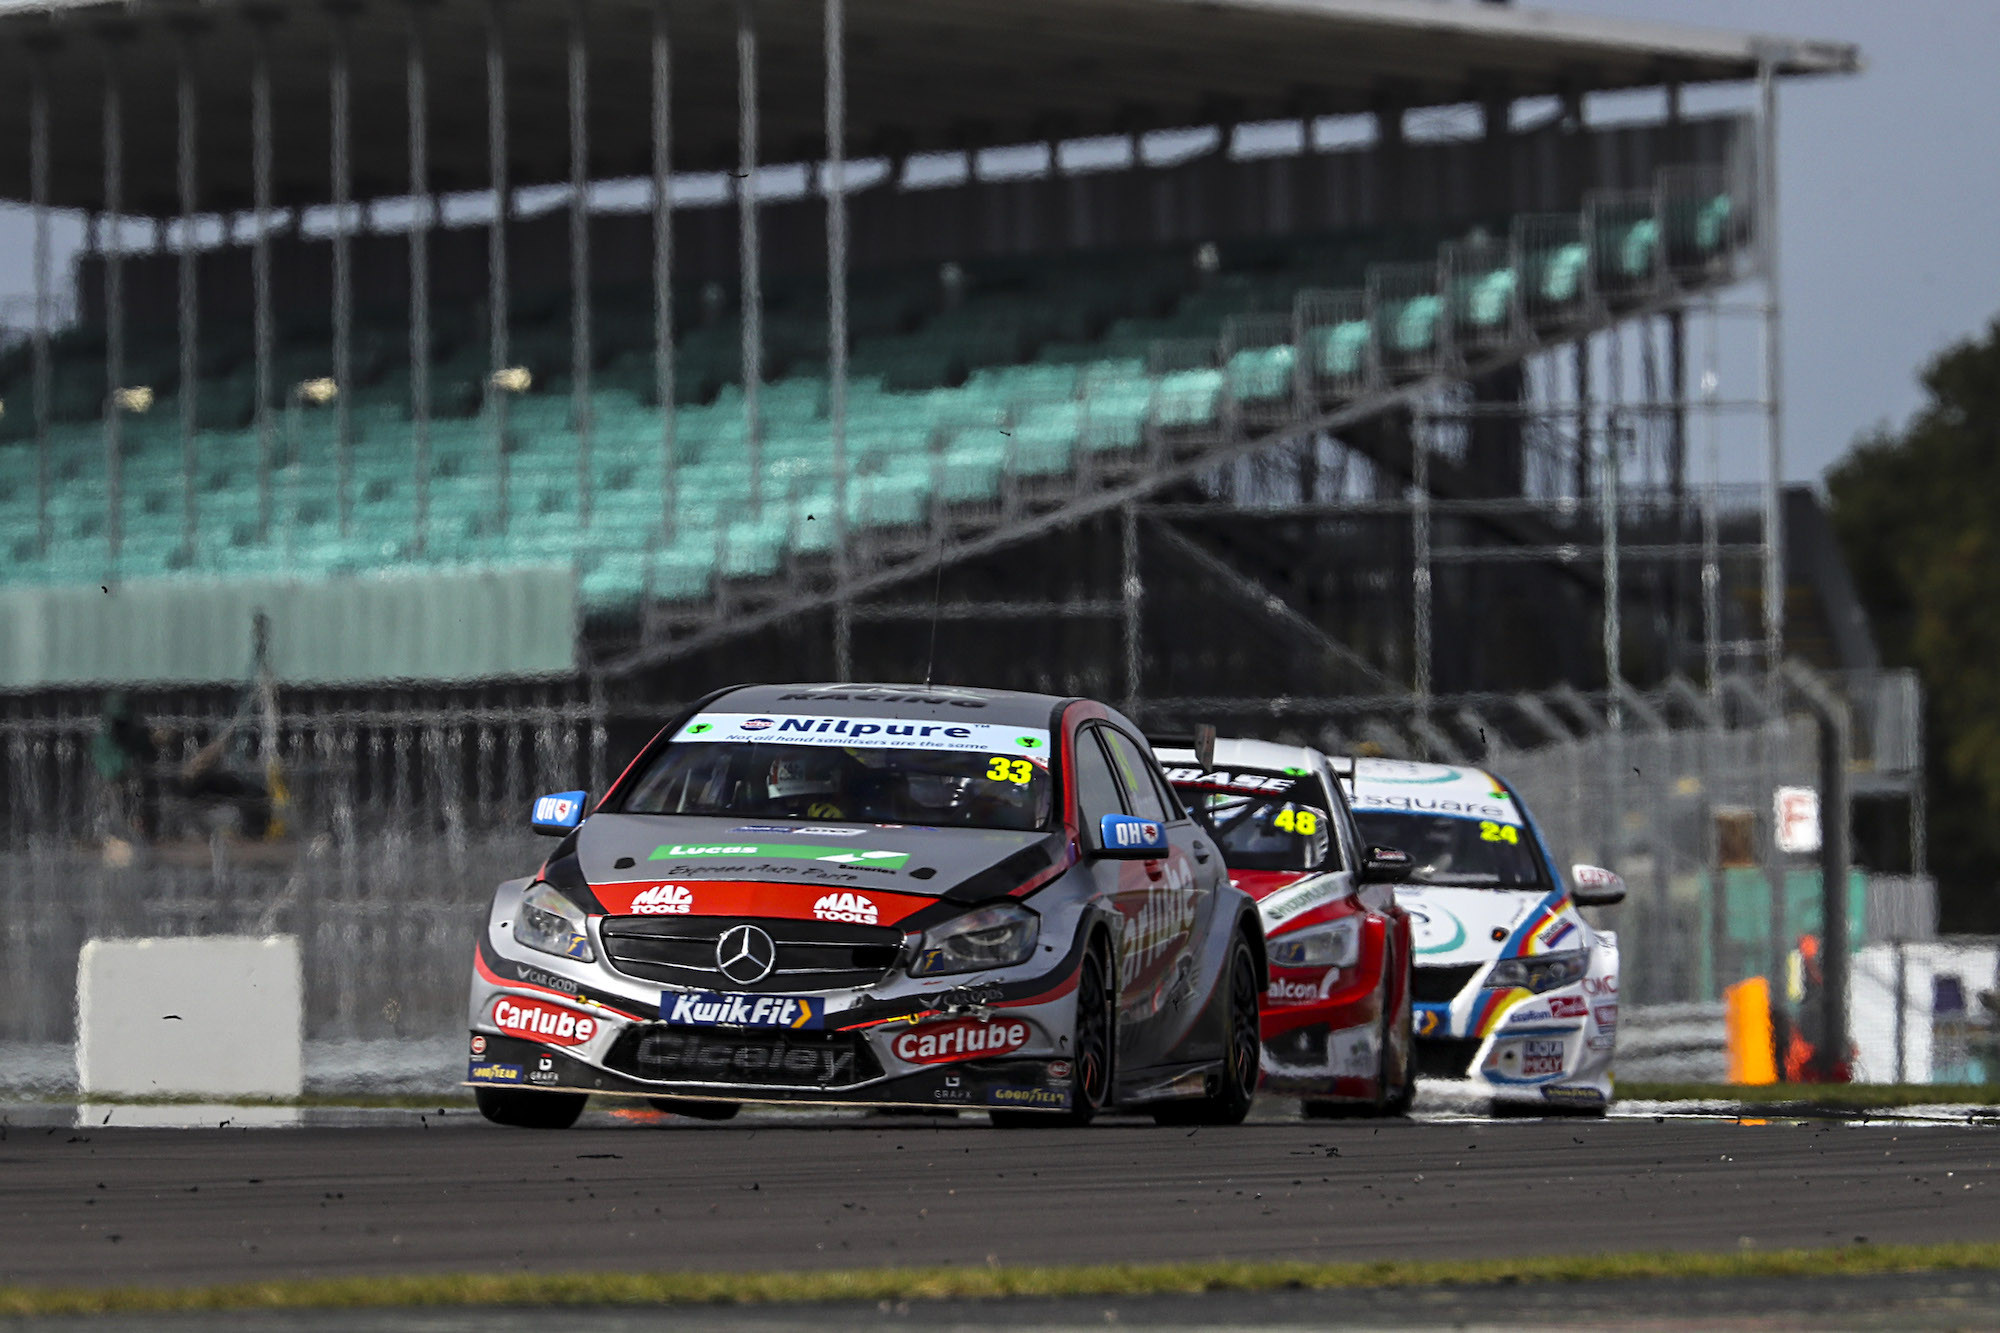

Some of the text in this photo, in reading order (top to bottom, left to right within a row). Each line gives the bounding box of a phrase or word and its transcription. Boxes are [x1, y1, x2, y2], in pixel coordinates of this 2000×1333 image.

[778, 718, 971, 739] Nilpure
[817, 737, 886, 745] sanitisers
[919, 740, 943, 748] the
[947, 742, 988, 750] same
[986, 757, 1033, 785] 33
[1162, 767, 1296, 793] BASE
[1274, 809, 1317, 836] 48
[1480, 820, 1519, 845] 24
[1115, 823, 1142, 846] QH
[669, 845, 758, 855] Lucas
[749, 863, 797, 874] Auto
[838, 864, 897, 875] Batteries
[632, 885, 693, 905] MAC
[814, 892, 878, 916] MAC
[631, 903, 691, 914] TOOLS
[813, 909, 878, 925] TOOLS
[529, 971, 578, 994] CAR GODS
[494, 1000, 593, 1041] Carlube
[897, 1023, 1025, 1059] Carlube
[472, 1065, 518, 1079] GOODYEAR
